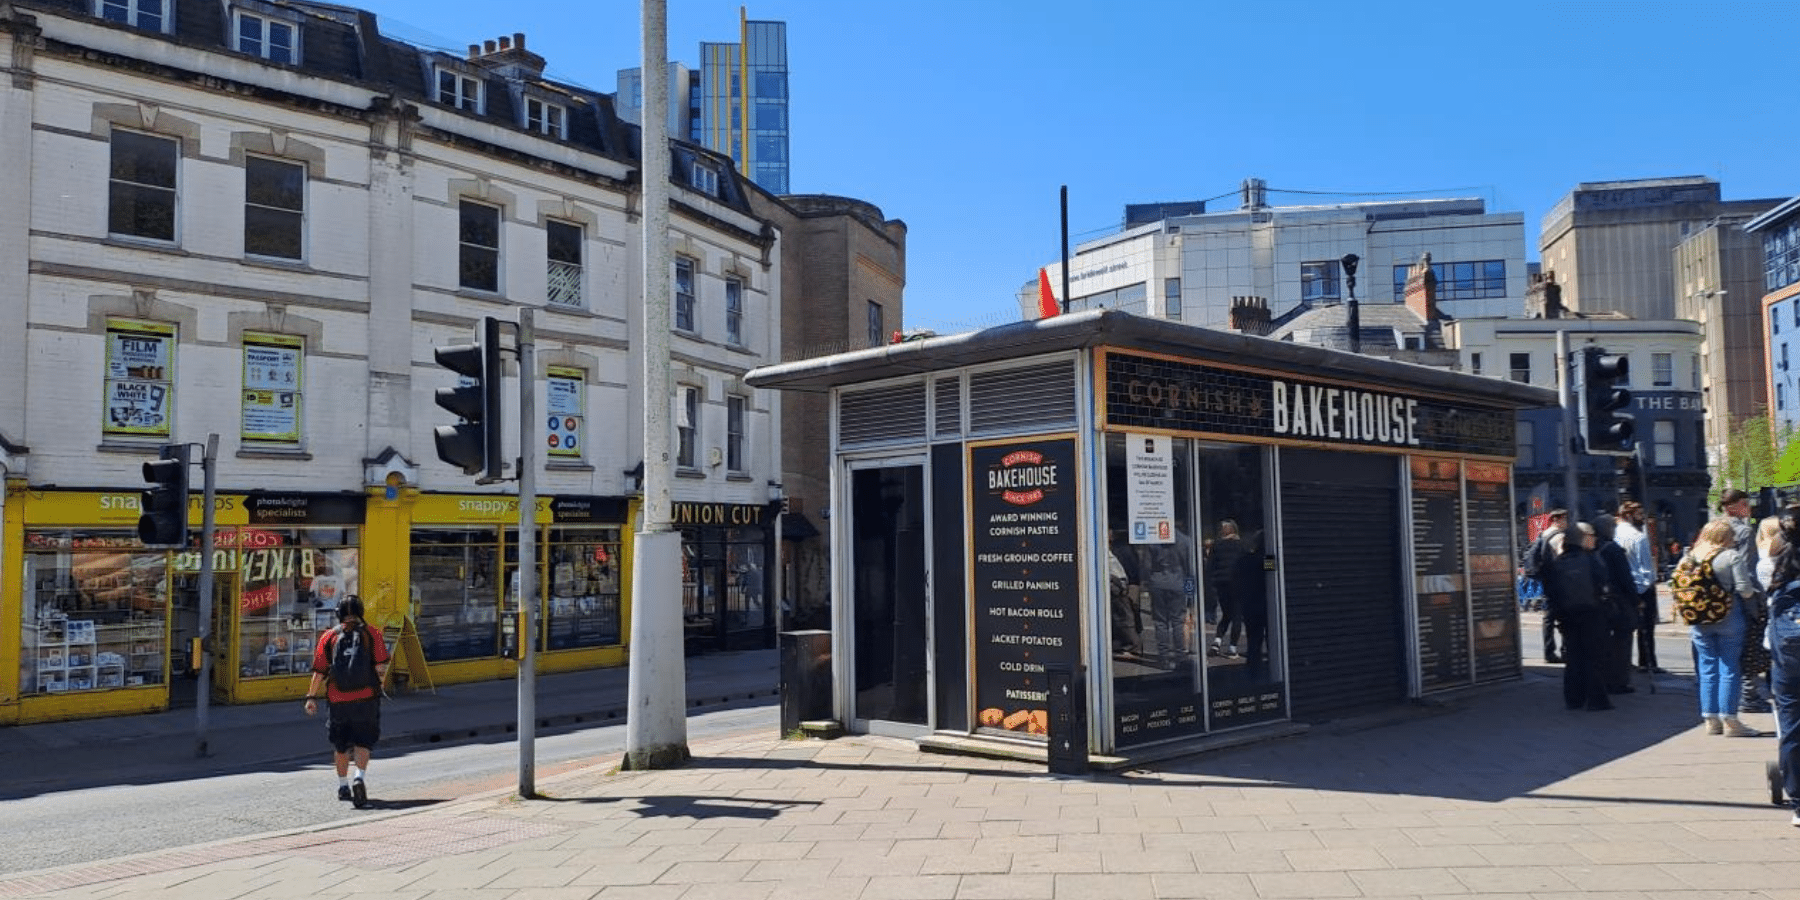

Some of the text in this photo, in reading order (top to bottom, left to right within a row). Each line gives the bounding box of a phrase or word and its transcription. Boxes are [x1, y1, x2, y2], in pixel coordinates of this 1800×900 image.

[122, 341, 157, 353] FILM
[117, 382, 147, 391] BLACK
[117, 391, 147, 400] WHITE
[1634, 396, 1674, 410] THE
[1129, 380, 1241, 413] CORNISH
[1272, 380, 1420, 445] BAKEHOUSE
[988, 465, 1058, 489] BAKEHOUSE
[732, 505, 761, 525] CUT
[990, 512, 1058, 522] AWARD WINNING
[989, 526, 1059, 536] CORNISH PASTIES
[978, 553, 1074, 563] FRESH GROUND COFFEE
[991, 580, 1060, 590] GRILLED PANINIS
[989, 607, 1064, 618] HOT BACON ROLLS
[991, 634, 1063, 647] JACKET POTATOES
[1000, 661, 1045, 673] COLD DRIN
[1006, 689, 1048, 702] PATISSERI
